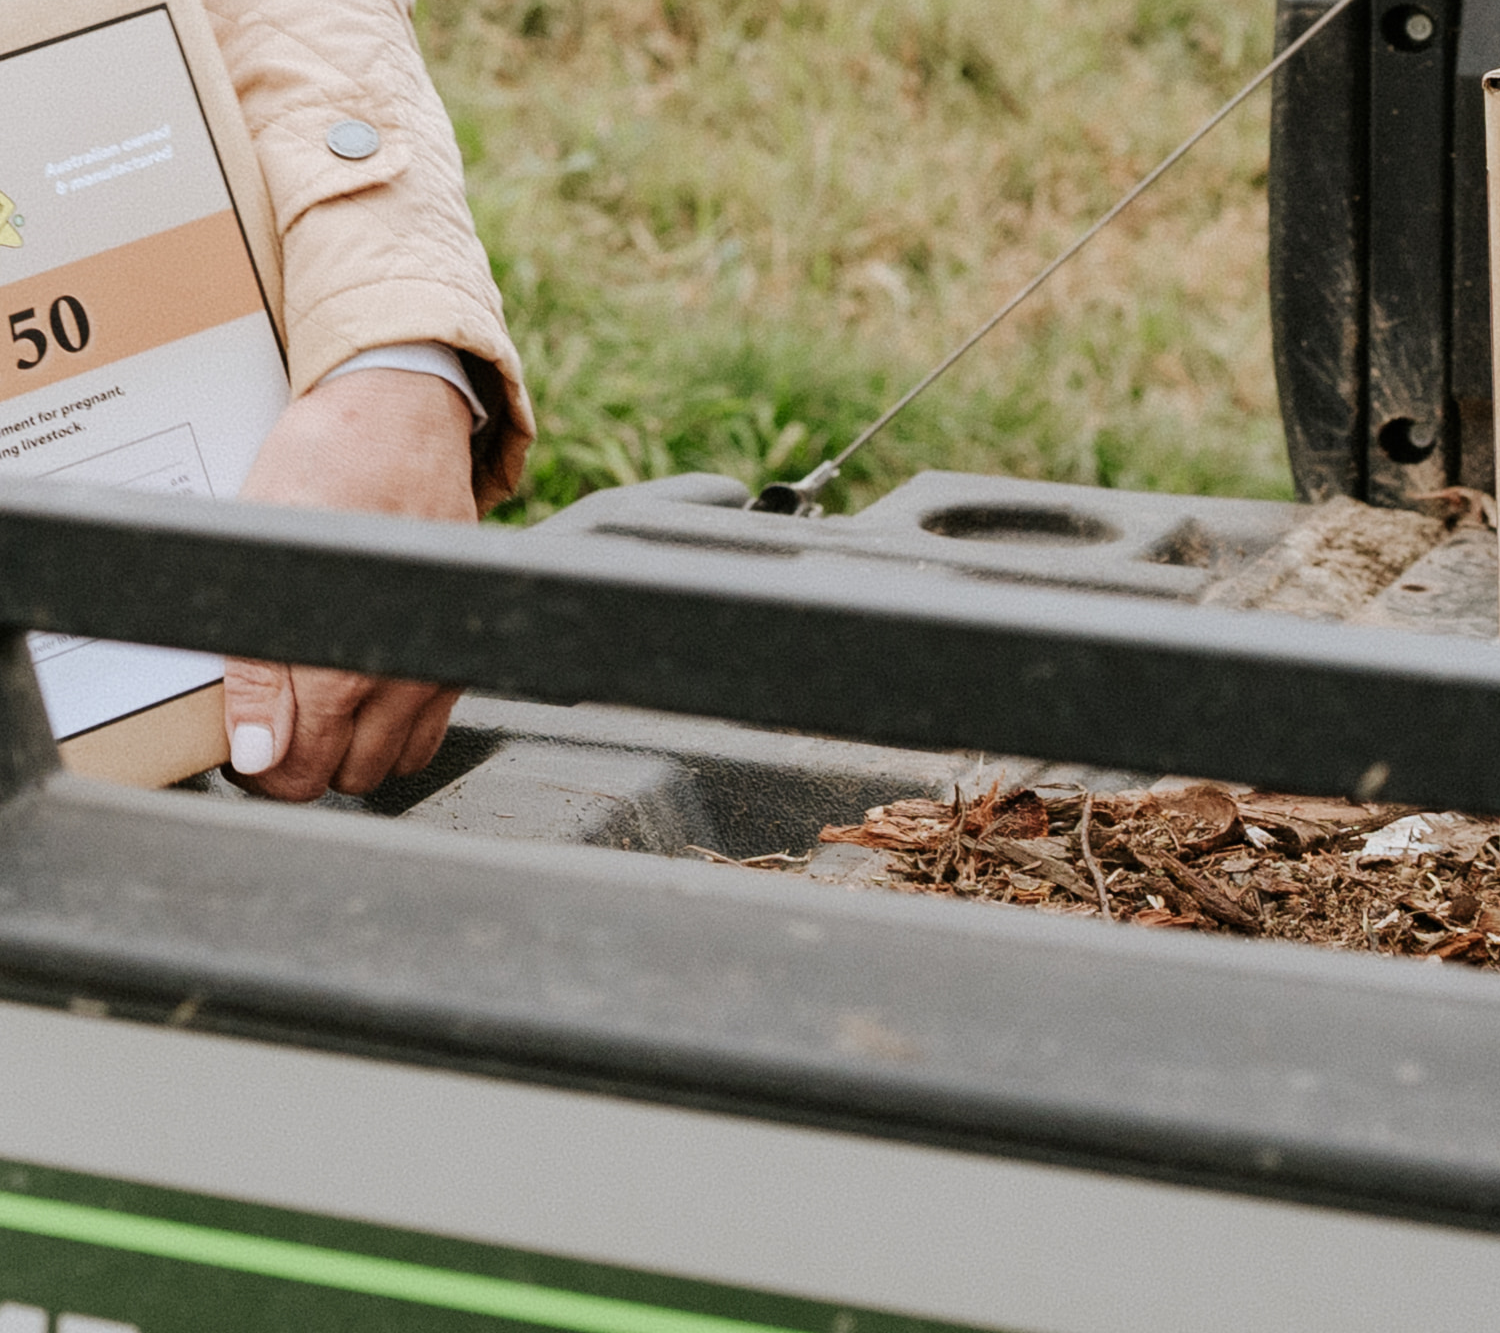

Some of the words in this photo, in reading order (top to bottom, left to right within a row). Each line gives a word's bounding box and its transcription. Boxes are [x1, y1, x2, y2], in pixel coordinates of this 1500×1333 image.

[8, 295, 91, 370] 50
[38, 410, 58, 425] for
[21, 420, 87, 452] livestock.
